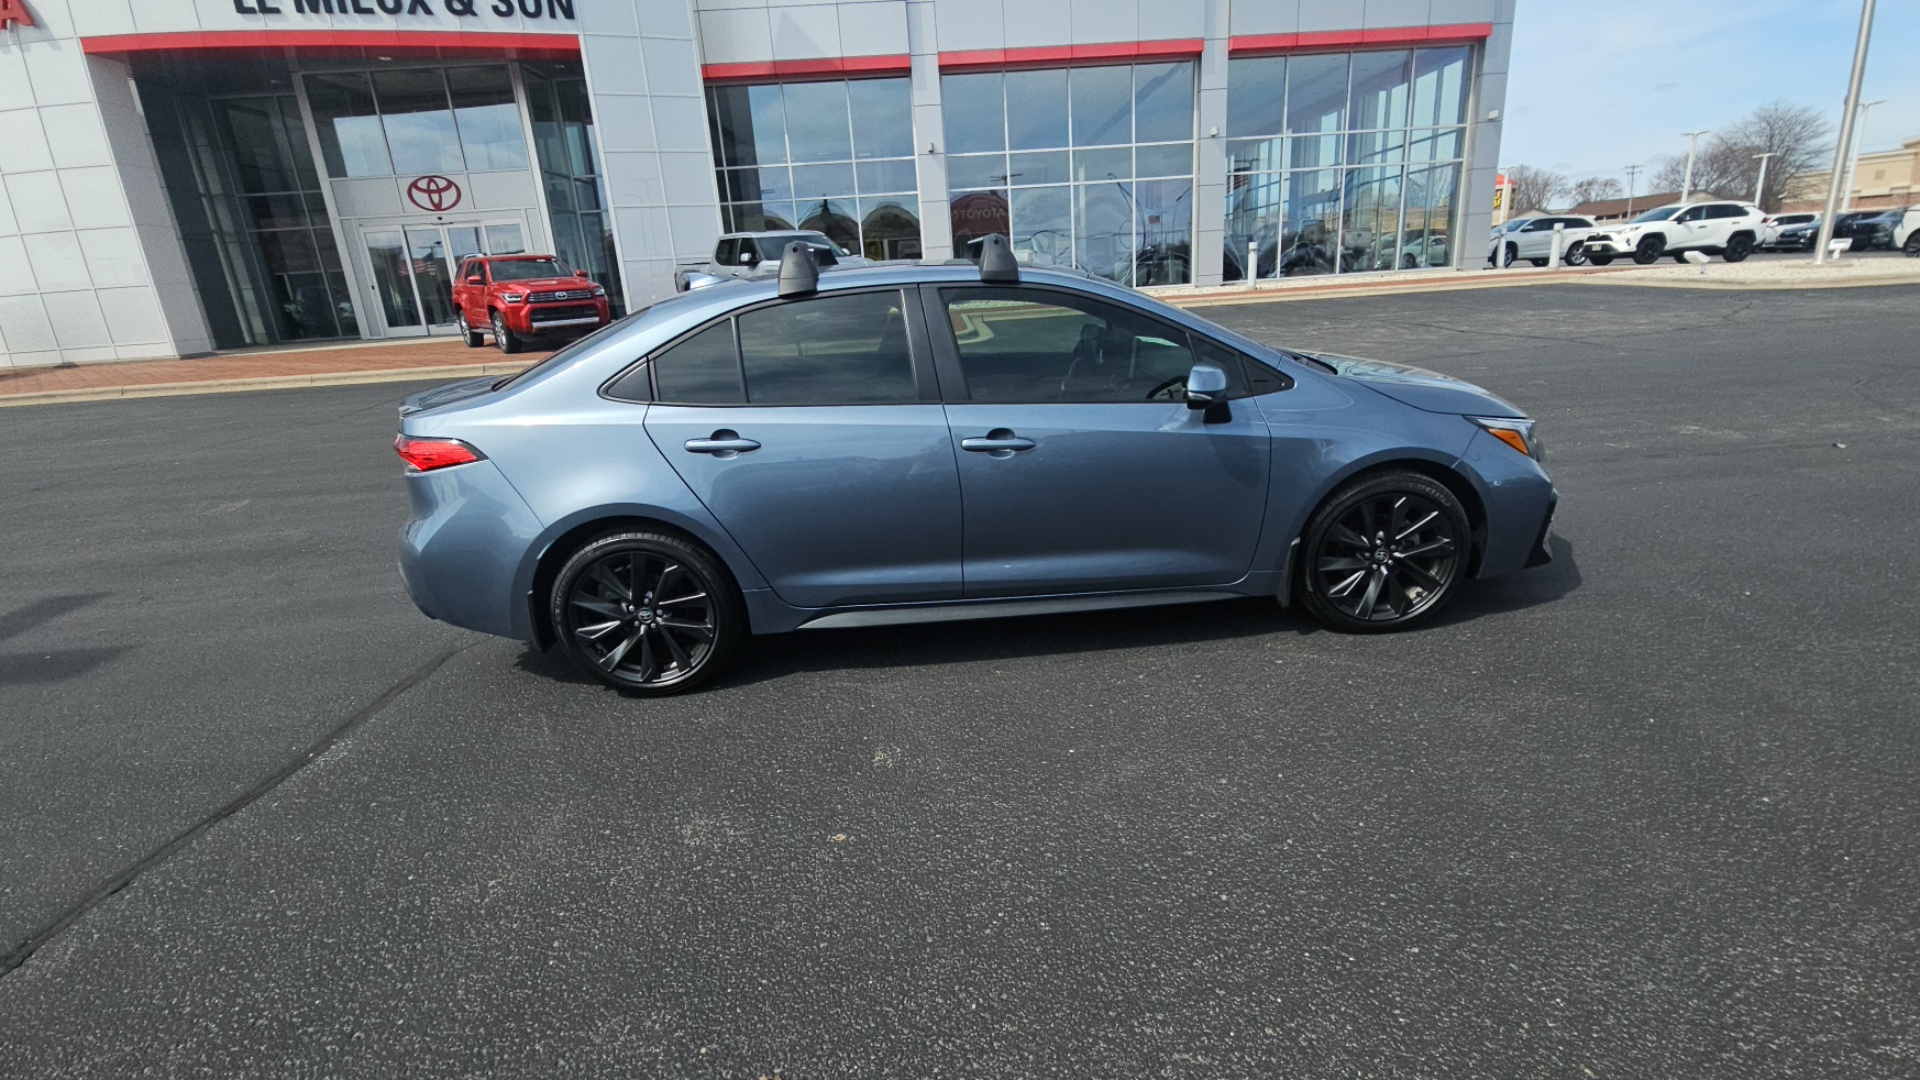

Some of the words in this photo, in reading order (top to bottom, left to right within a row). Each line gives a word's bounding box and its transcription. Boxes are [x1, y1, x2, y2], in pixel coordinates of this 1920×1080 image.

[444, 0, 478, 17] &
[490, 0, 575, 20] SON
[960, 208, 1005, 219] TOYOTA
